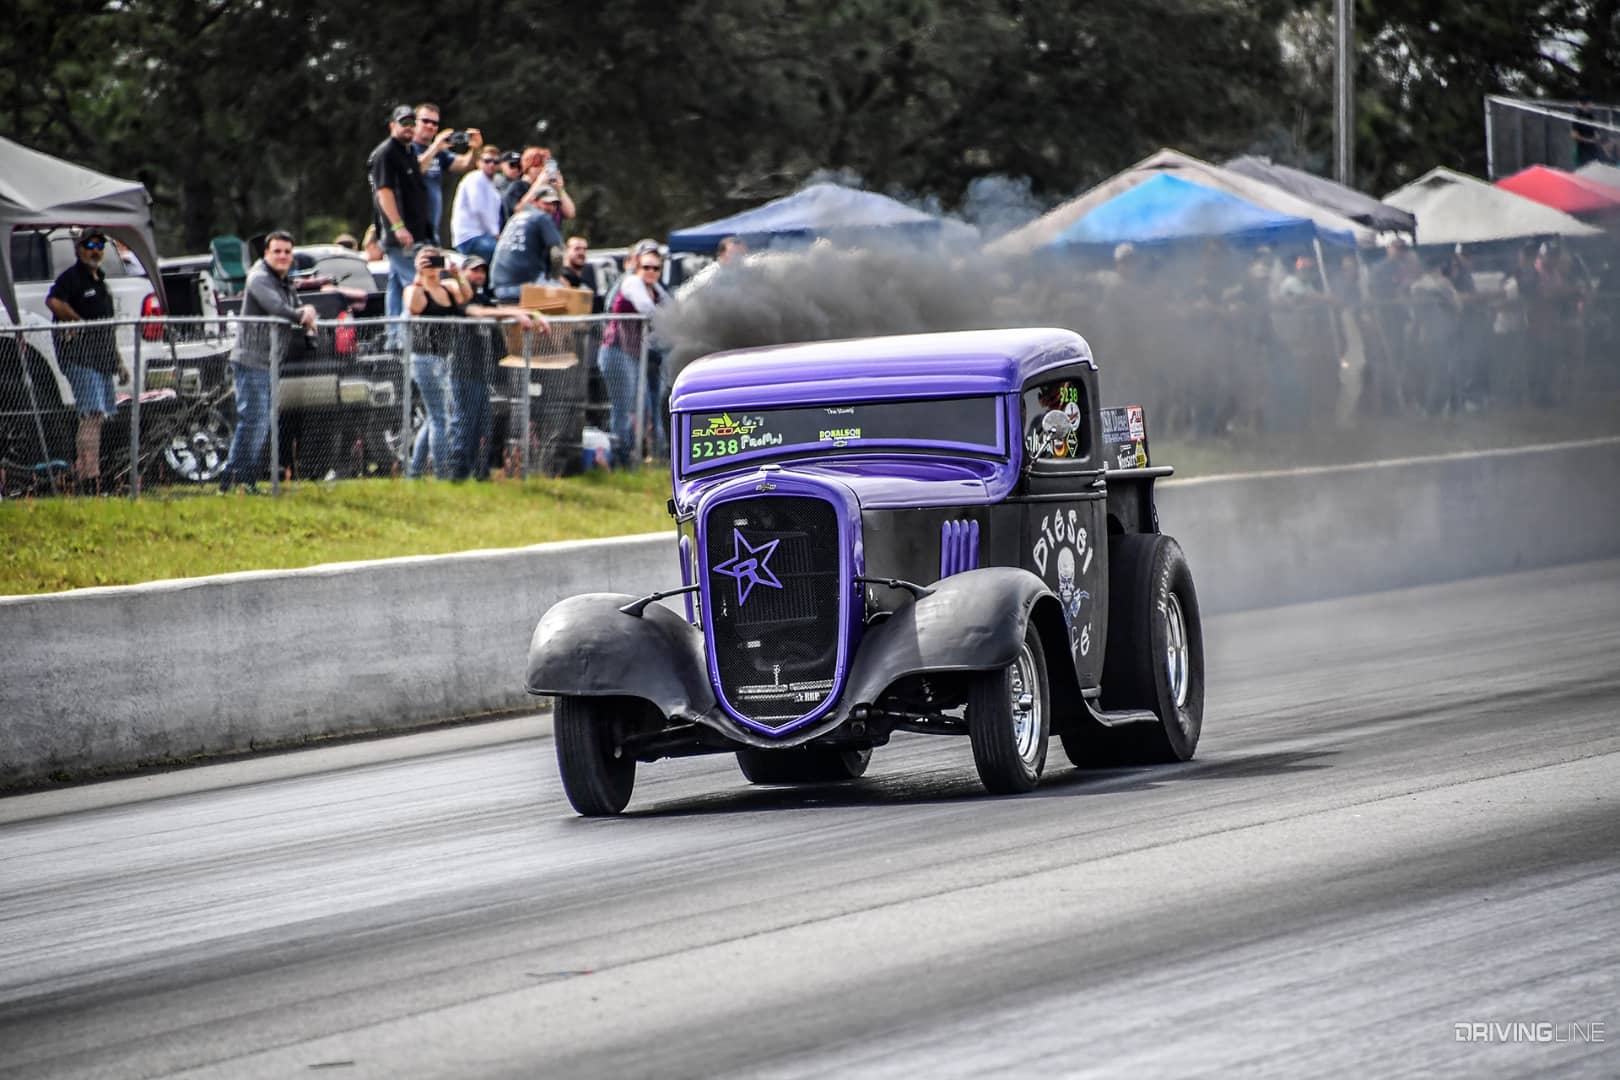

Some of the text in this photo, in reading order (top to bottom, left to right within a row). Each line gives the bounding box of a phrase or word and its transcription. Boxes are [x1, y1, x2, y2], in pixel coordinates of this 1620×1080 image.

[1060, 387, 1078, 402] 5238
[691, 425, 757, 438] SUNCOAST
[692, 439, 738, 458] 5238
